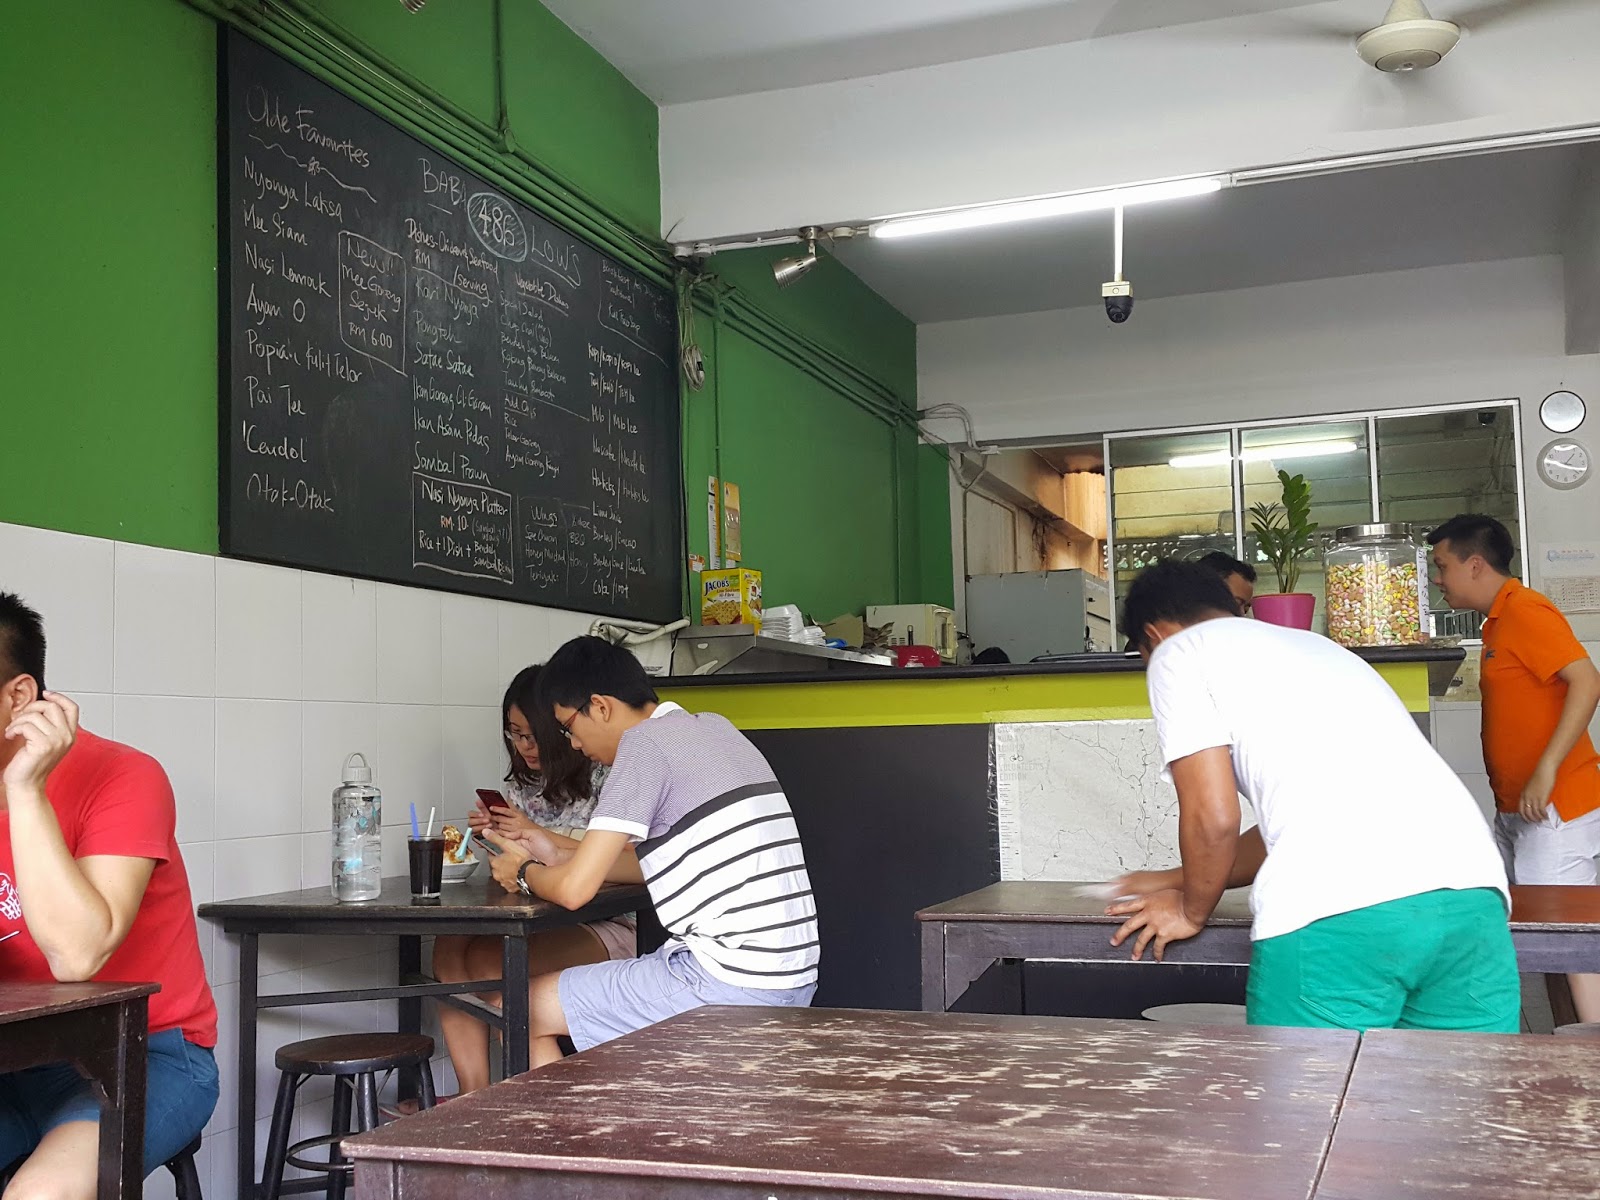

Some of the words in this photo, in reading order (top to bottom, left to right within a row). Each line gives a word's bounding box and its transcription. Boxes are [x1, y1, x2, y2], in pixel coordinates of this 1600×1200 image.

[246, 85, 291, 133] Olde
[295, 106, 370, 167] Favourites
[244, 156, 298, 209] Nyonya
[304, 182, 343, 222] Laksa
[418, 158, 467, 211] BABA
[244, 203, 268, 233] Mee
[273, 213, 308, 246] Siam
[478, 199, 515, 246] 486
[245, 241, 275, 275] Nasi
[281, 252, 331, 297] Lemak
[415, 249, 431, 269] RM
[247, 283, 282, 325] Ayam
[367, 276, 402, 312] Goreng
[416, 275, 439, 300] Kari
[445, 284, 479, 325] Nyonya
[348, 322, 367, 345] RM
[371, 329, 393, 349] 6.00
[334, 353, 362, 382] Telor
[413, 375, 429, 401] Ikan
[244, 376, 272, 408] Pai
[279, 385, 307, 416] Tee
[413, 406, 436, 434] Ikan
[437, 414, 463, 439] Asam
[464, 418, 490, 454] Pedas
[413, 441, 456, 474] Sambal
[460, 454, 492, 486] Prawn
[247, 473, 334, 512] Otak-Otak
[421, 480, 444, 504] Nasi
[448, 485, 479, 514] Nyonya
[481, 491, 508, 516] Platter
[419, 530, 434, 550] Rice
[704, 580, 730, 596] JACOB'S
